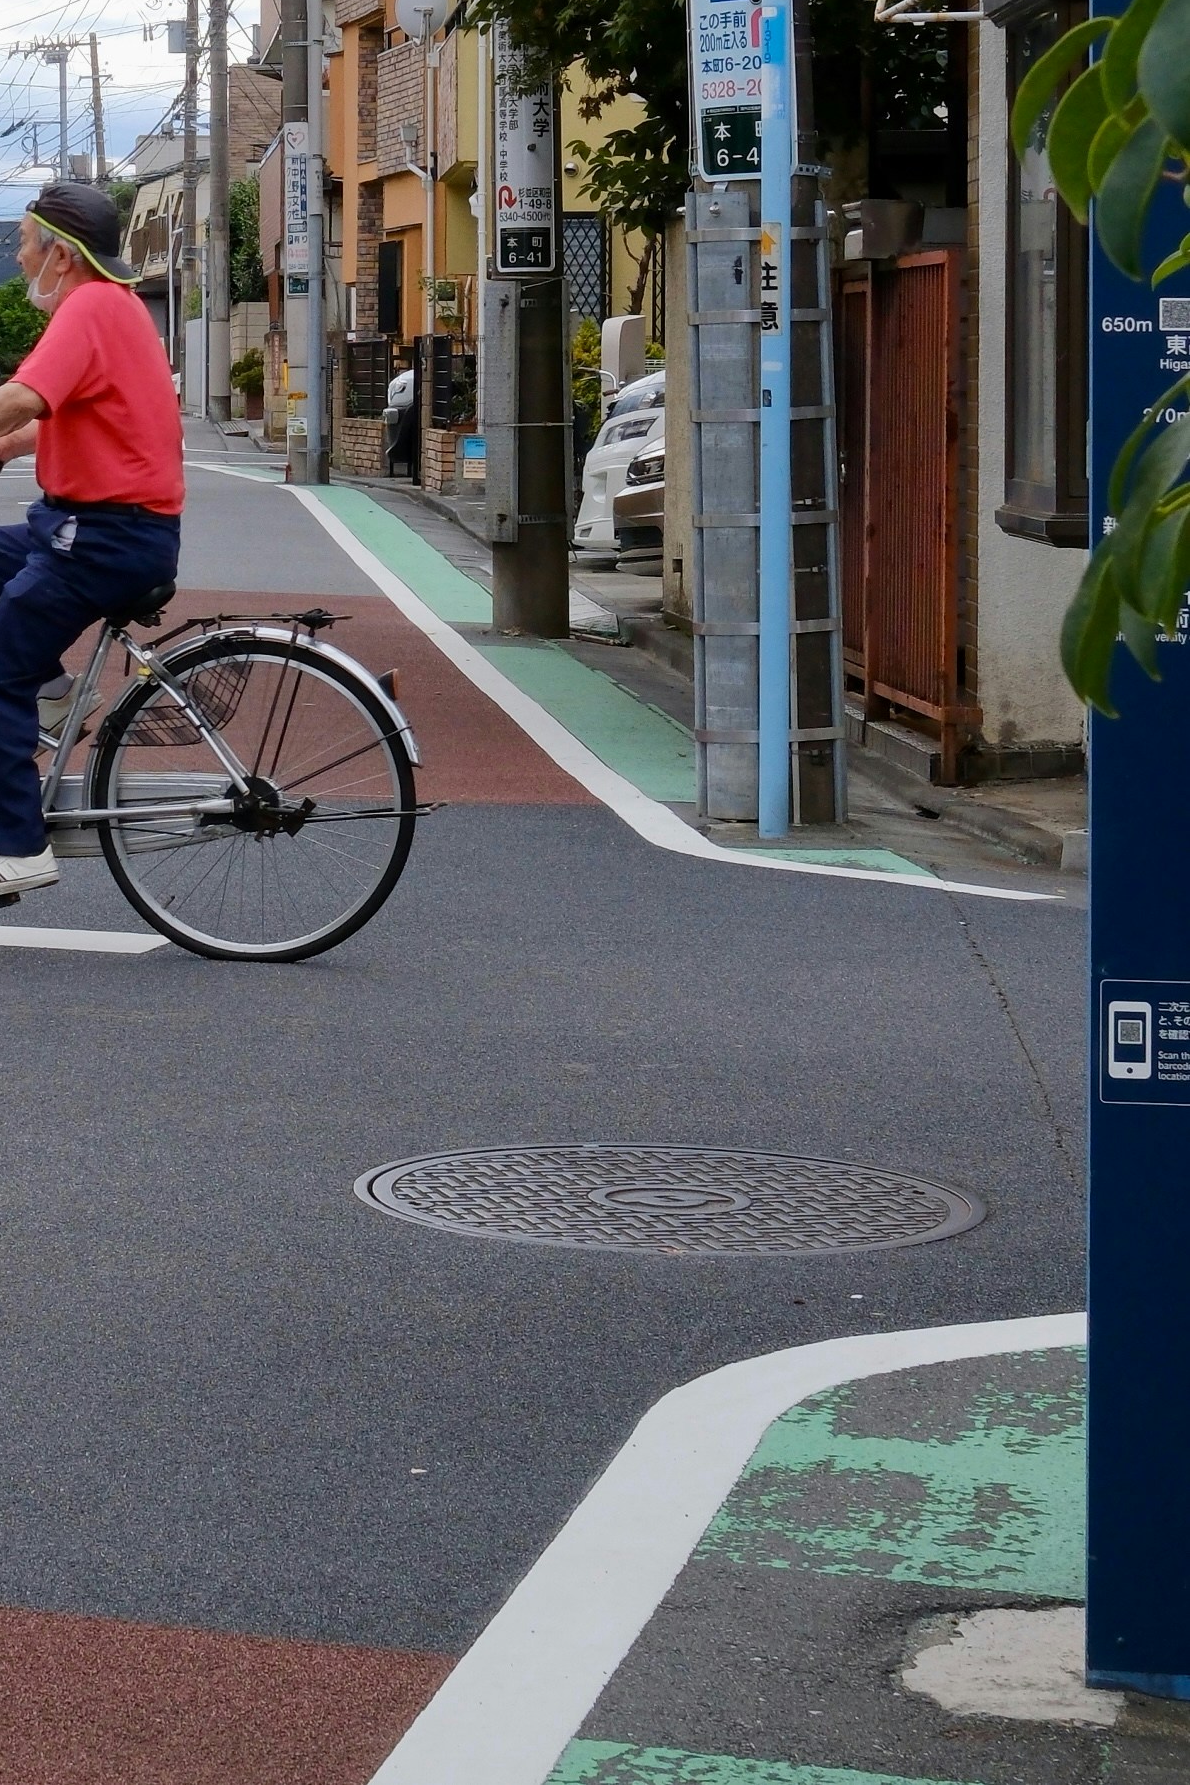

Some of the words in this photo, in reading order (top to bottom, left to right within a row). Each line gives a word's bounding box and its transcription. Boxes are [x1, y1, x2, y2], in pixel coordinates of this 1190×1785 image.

[699, 10, 747, 31] この手前
[700, 30, 748, 53] 200m左入る
[701, 55, 762, 74] 本町6-20
[508, 252, 542, 264] 6-41
[1101, 316, 1152, 333] 650m
[1166, 334, 1190, 356] 東
[1158, 1029, 1190, 1041] を確認
[1157, 1051, 1179, 1060] Scan
[1157, 1061, 1190, 1071] barcod
